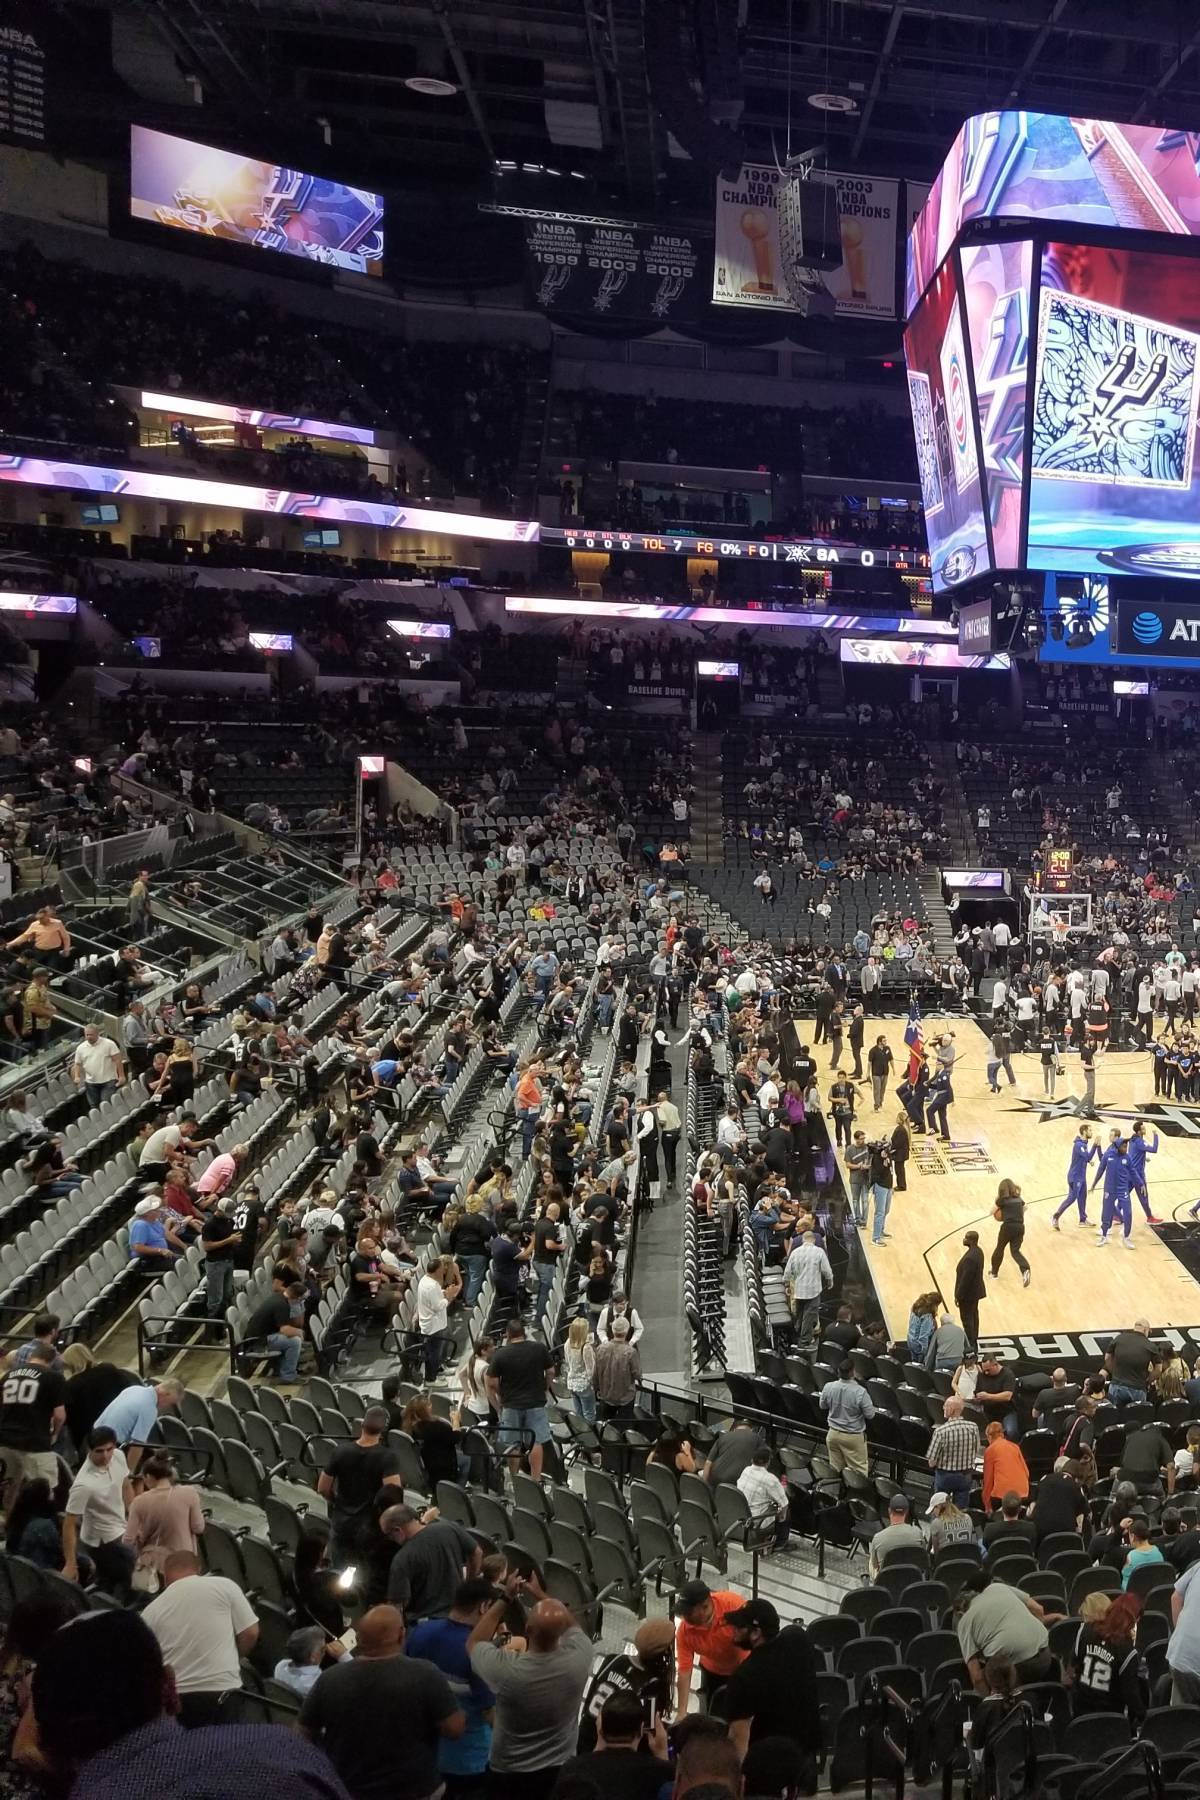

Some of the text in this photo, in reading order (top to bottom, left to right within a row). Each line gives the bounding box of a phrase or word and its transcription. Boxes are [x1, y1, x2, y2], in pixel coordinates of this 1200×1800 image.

[744, 170, 780, 184] 1999
[748, 183, 774, 196] NBA
[837, 179, 873, 193] 2003
[723, 191, 778, 208] CHAMPI
[842, 192, 867, 206] NBA
[839, 203, 890, 219] AMPIONS
[543, 223, 576, 236] NBA
[533, 232, 575, 242] WESTERN
[600, 230, 634, 243] NBA
[658, 236, 692, 248] NBA
[526, 238, 582, 249] CONFERENCE
[530, 244, 581, 255] CHAMPIONS
[584, 244, 640, 255] CONFERENCE
[591, 238, 634, 249] WESTERN
[651, 245, 691, 255] WESTERN
[535, 252, 578, 266] 1999
[586, 250, 638, 261] CHAMPIONS
[588, 257, 636, 272] 2003
[646, 264, 693, 278] 2005
[716, 290, 733, 299] SAN
[735, 292, 771, 301] ANTONIO
[567, 538, 575, 547] 0
[586, 539, 594, 548] 0
[604, 540, 612, 549] 0
[622, 541, 630, 550] 0
[642, 538, 665, 550] TOL
[673, 540, 682, 551] 7
[697, 542, 713, 553] FG
[721, 543, 741, 556] 0%
[748, 545, 756, 556] F
[759, 545, 769, 557] 0
[816, 548, 839, 563] SA
[861, 550, 874, 566] 0
[1051, 852, 1070, 860] 12:00
[1050, 860, 1068, 872] 24
[938, 1139, 999, 1174] AT&T
[2, 1379, 40, 1404] 20
[1085, 1644, 1115, 1663] ALDRIDGE
[607, 1671, 633, 1690] DUNCA
[1079, 1656, 1113, 1692] 12
